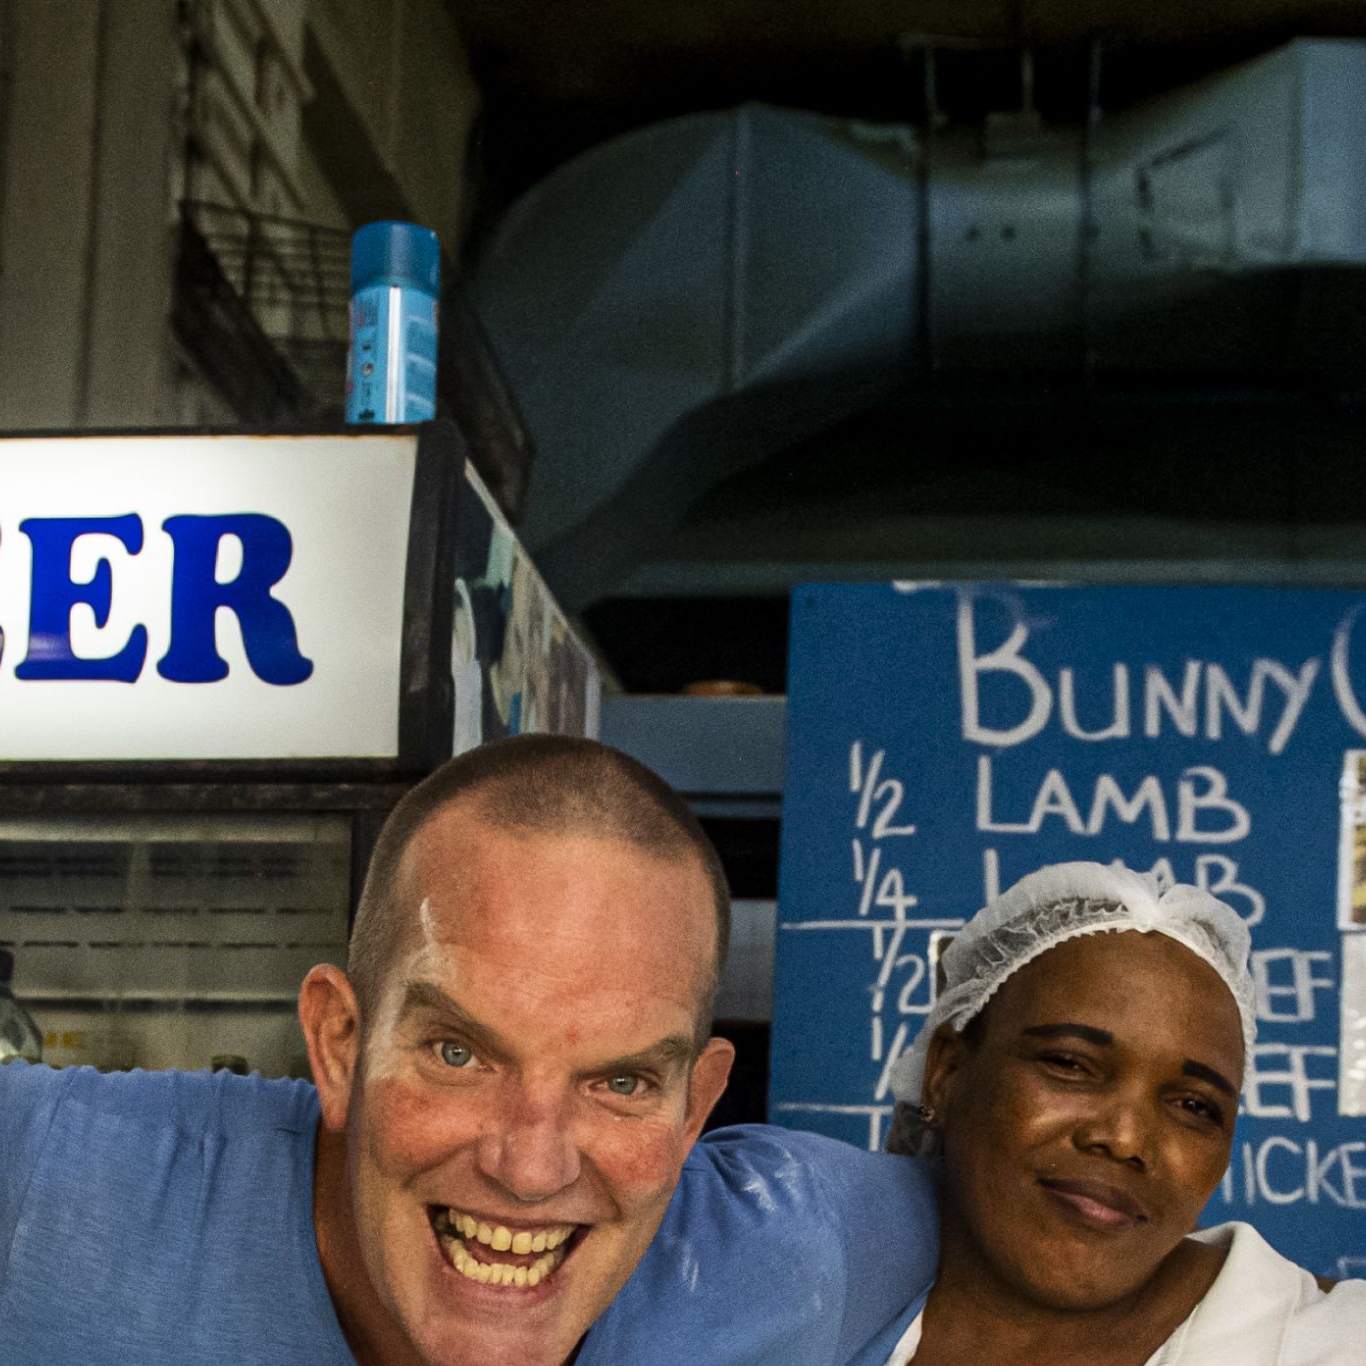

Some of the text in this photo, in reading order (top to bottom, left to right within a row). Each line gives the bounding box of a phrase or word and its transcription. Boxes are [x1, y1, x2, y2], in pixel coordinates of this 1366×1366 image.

[955, 582, 1320, 756] BUNNY
[849, 740, 917, 840] 1/2
[976, 754, 1252, 844] LAMB
